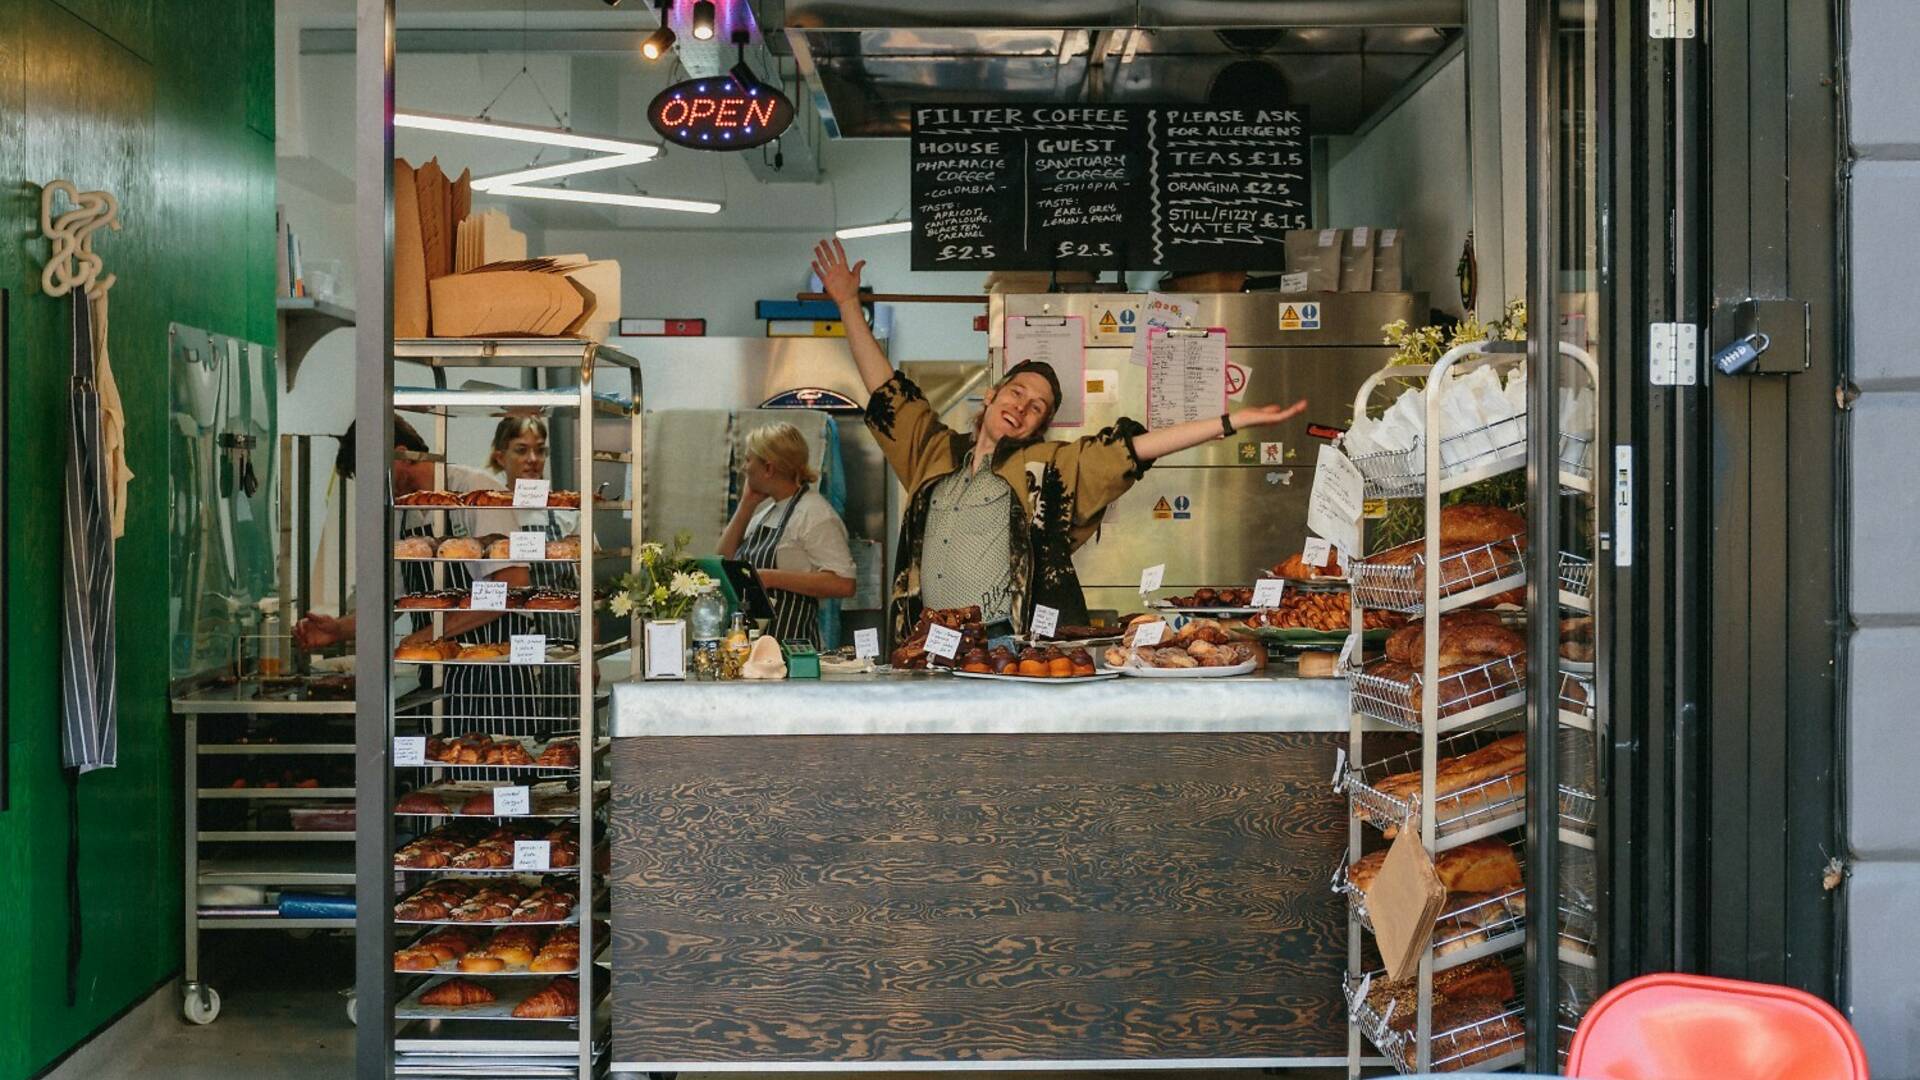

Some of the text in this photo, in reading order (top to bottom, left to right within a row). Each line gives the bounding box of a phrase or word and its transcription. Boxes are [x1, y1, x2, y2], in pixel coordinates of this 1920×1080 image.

[661, 99, 775, 127] OPEN
[917, 108, 1129, 126] FILTER COFFEE
[1166, 110, 1301, 124] PLEASE ASK
[1168, 126, 1301, 137] FOR ALLERGENS
[919, 142, 1000, 154] HOUSE
[1037, 139, 1117, 153] GUEST
[1035, 154, 1126, 171] SANCTUARY
[1169, 151, 1303, 166] TEAS £1.5
[916, 159, 1006, 172] PHARMACIE
[937, 171, 996, 182] COFFEE
[1055, 168, 1125, 180] COFFEE
[1167, 181, 1290, 195] ORANGINA £2.5
[919, 202, 960, 213] TASTE:
[1036, 198, 1079, 208] TASTE:
[1054, 207, 1083, 217] EARL
[1168, 206, 1306, 230] STILL/FIZZY £1.5
[1042, 217, 1079, 227] LEMON
[1090, 213, 1122, 223] PEACH
[926, 226, 958, 238] BLACK
[1168, 222, 1255, 234] WATER
[937, 230, 985, 241] CARAMEL
[935, 245, 996, 262] £2.5
[1055, 241, 1114, 259] £2.5
